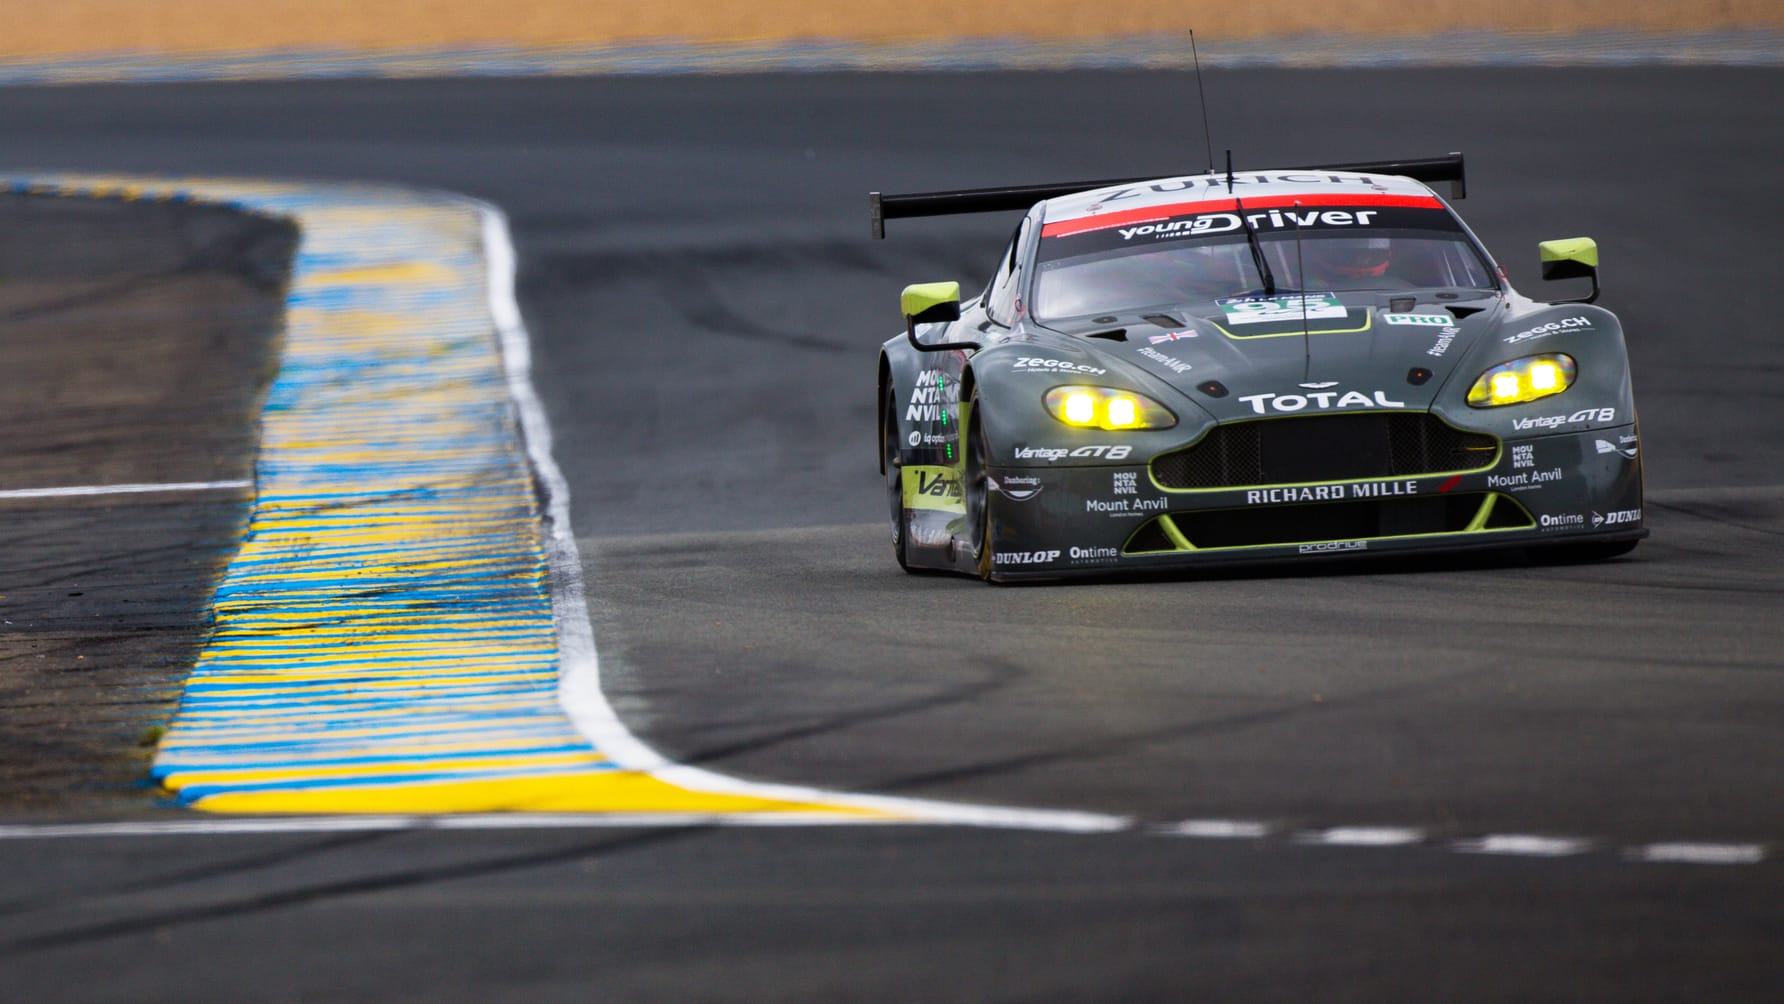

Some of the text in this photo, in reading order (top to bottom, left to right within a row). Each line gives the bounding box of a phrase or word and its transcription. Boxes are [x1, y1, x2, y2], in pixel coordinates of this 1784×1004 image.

[1100, 174, 1374, 202] ZURICH
[1390, 315, 1448, 324] PRO
[1238, 391, 1406, 414] TOTAL
[1512, 407, 1616, 431] Vantage GT8
[1014, 445, 1134, 461] Vantage GT8
[1512, 445, 1534, 453] MOU
[1513, 453, 1534, 461] NTA
[1514, 460, 1535, 469] NVIL
[1114, 472, 1137, 480] MOU
[1488, 468, 1562, 488] Mount Anvil
[1114, 487, 1138, 495] NVIL
[1247, 481, 1418, 505] RICHARD MILLE
[1086, 497, 1168, 513] Mount Anvil
[1540, 513, 1584, 527] Ontime
[996, 550, 1061, 564] DUNLOP
[1069, 546, 1118, 559] Ontime
